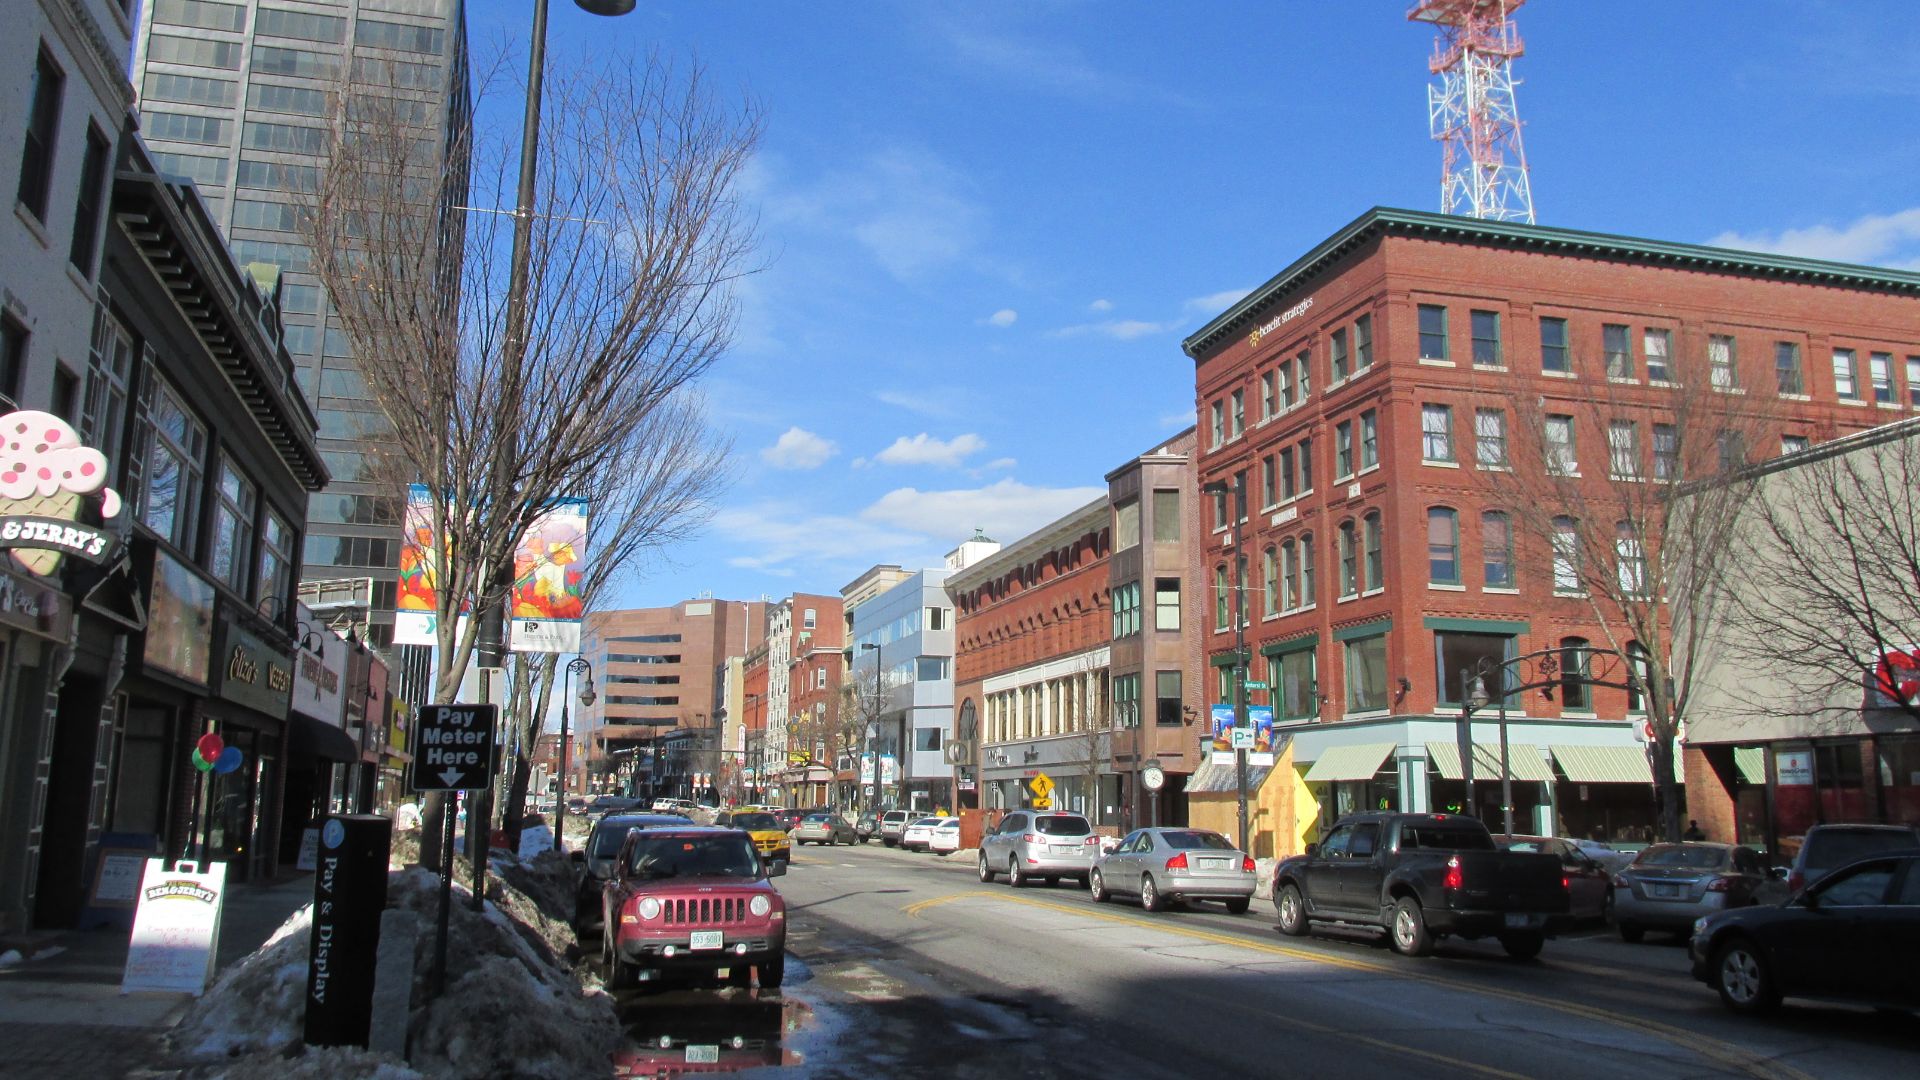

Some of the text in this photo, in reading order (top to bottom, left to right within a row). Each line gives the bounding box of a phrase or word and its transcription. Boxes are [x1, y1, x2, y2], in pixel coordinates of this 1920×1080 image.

[1260, 297, 1313, 338] benefit strategies
[20, 521, 107, 555] JERRY'S
[230, 644, 259, 685] Eliza's
[437, 707, 475, 728] Pay
[423, 727, 486, 745] Meter
[426, 748, 479, 765] Here
[312, 857, 338, 1004] Pay & Display
